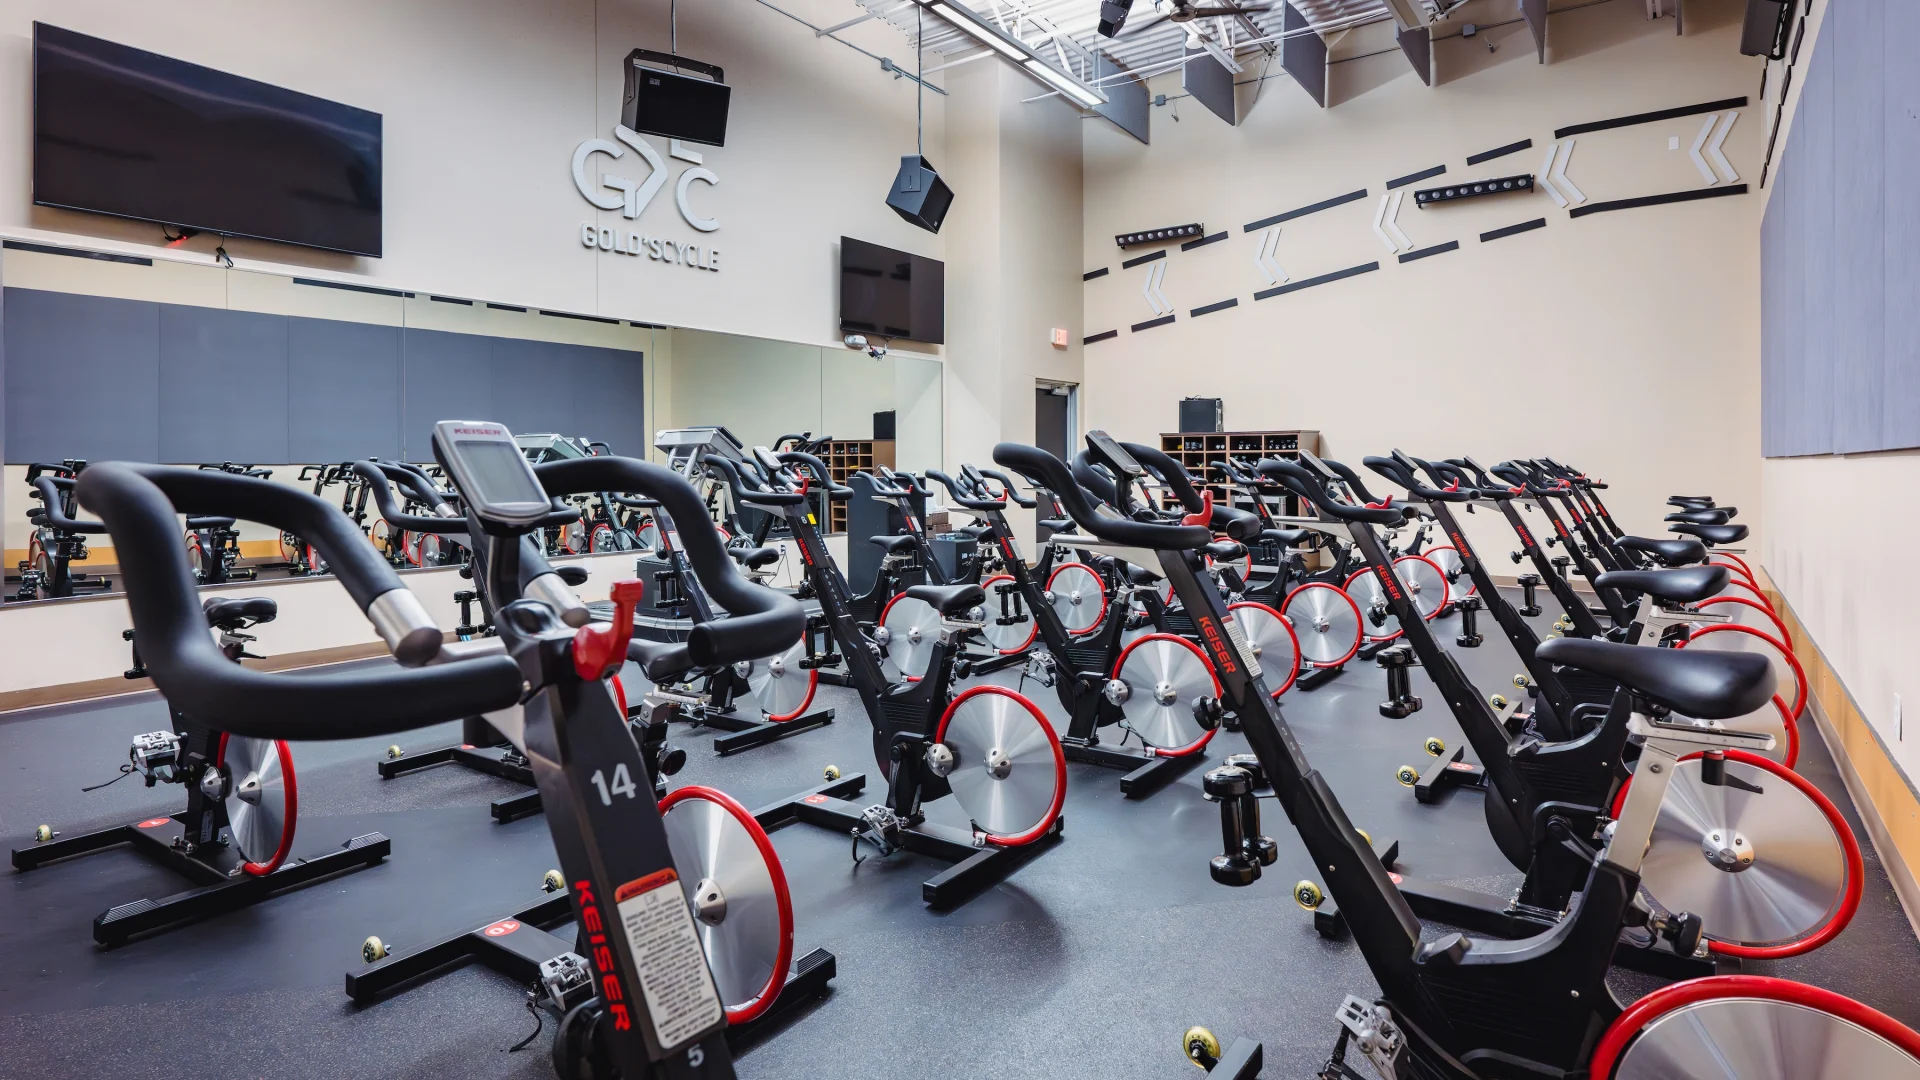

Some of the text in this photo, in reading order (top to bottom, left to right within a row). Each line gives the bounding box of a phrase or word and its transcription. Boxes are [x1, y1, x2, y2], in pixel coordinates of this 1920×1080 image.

[453, 427, 502, 436] KEISER
[1451, 532, 1471, 558] KEISER
[1376, 564, 1401, 600] KEISER
[1198, 616, 1236, 674] KEISER
[591, 763, 637, 806] 14
[574, 879, 632, 1032] KEISER
